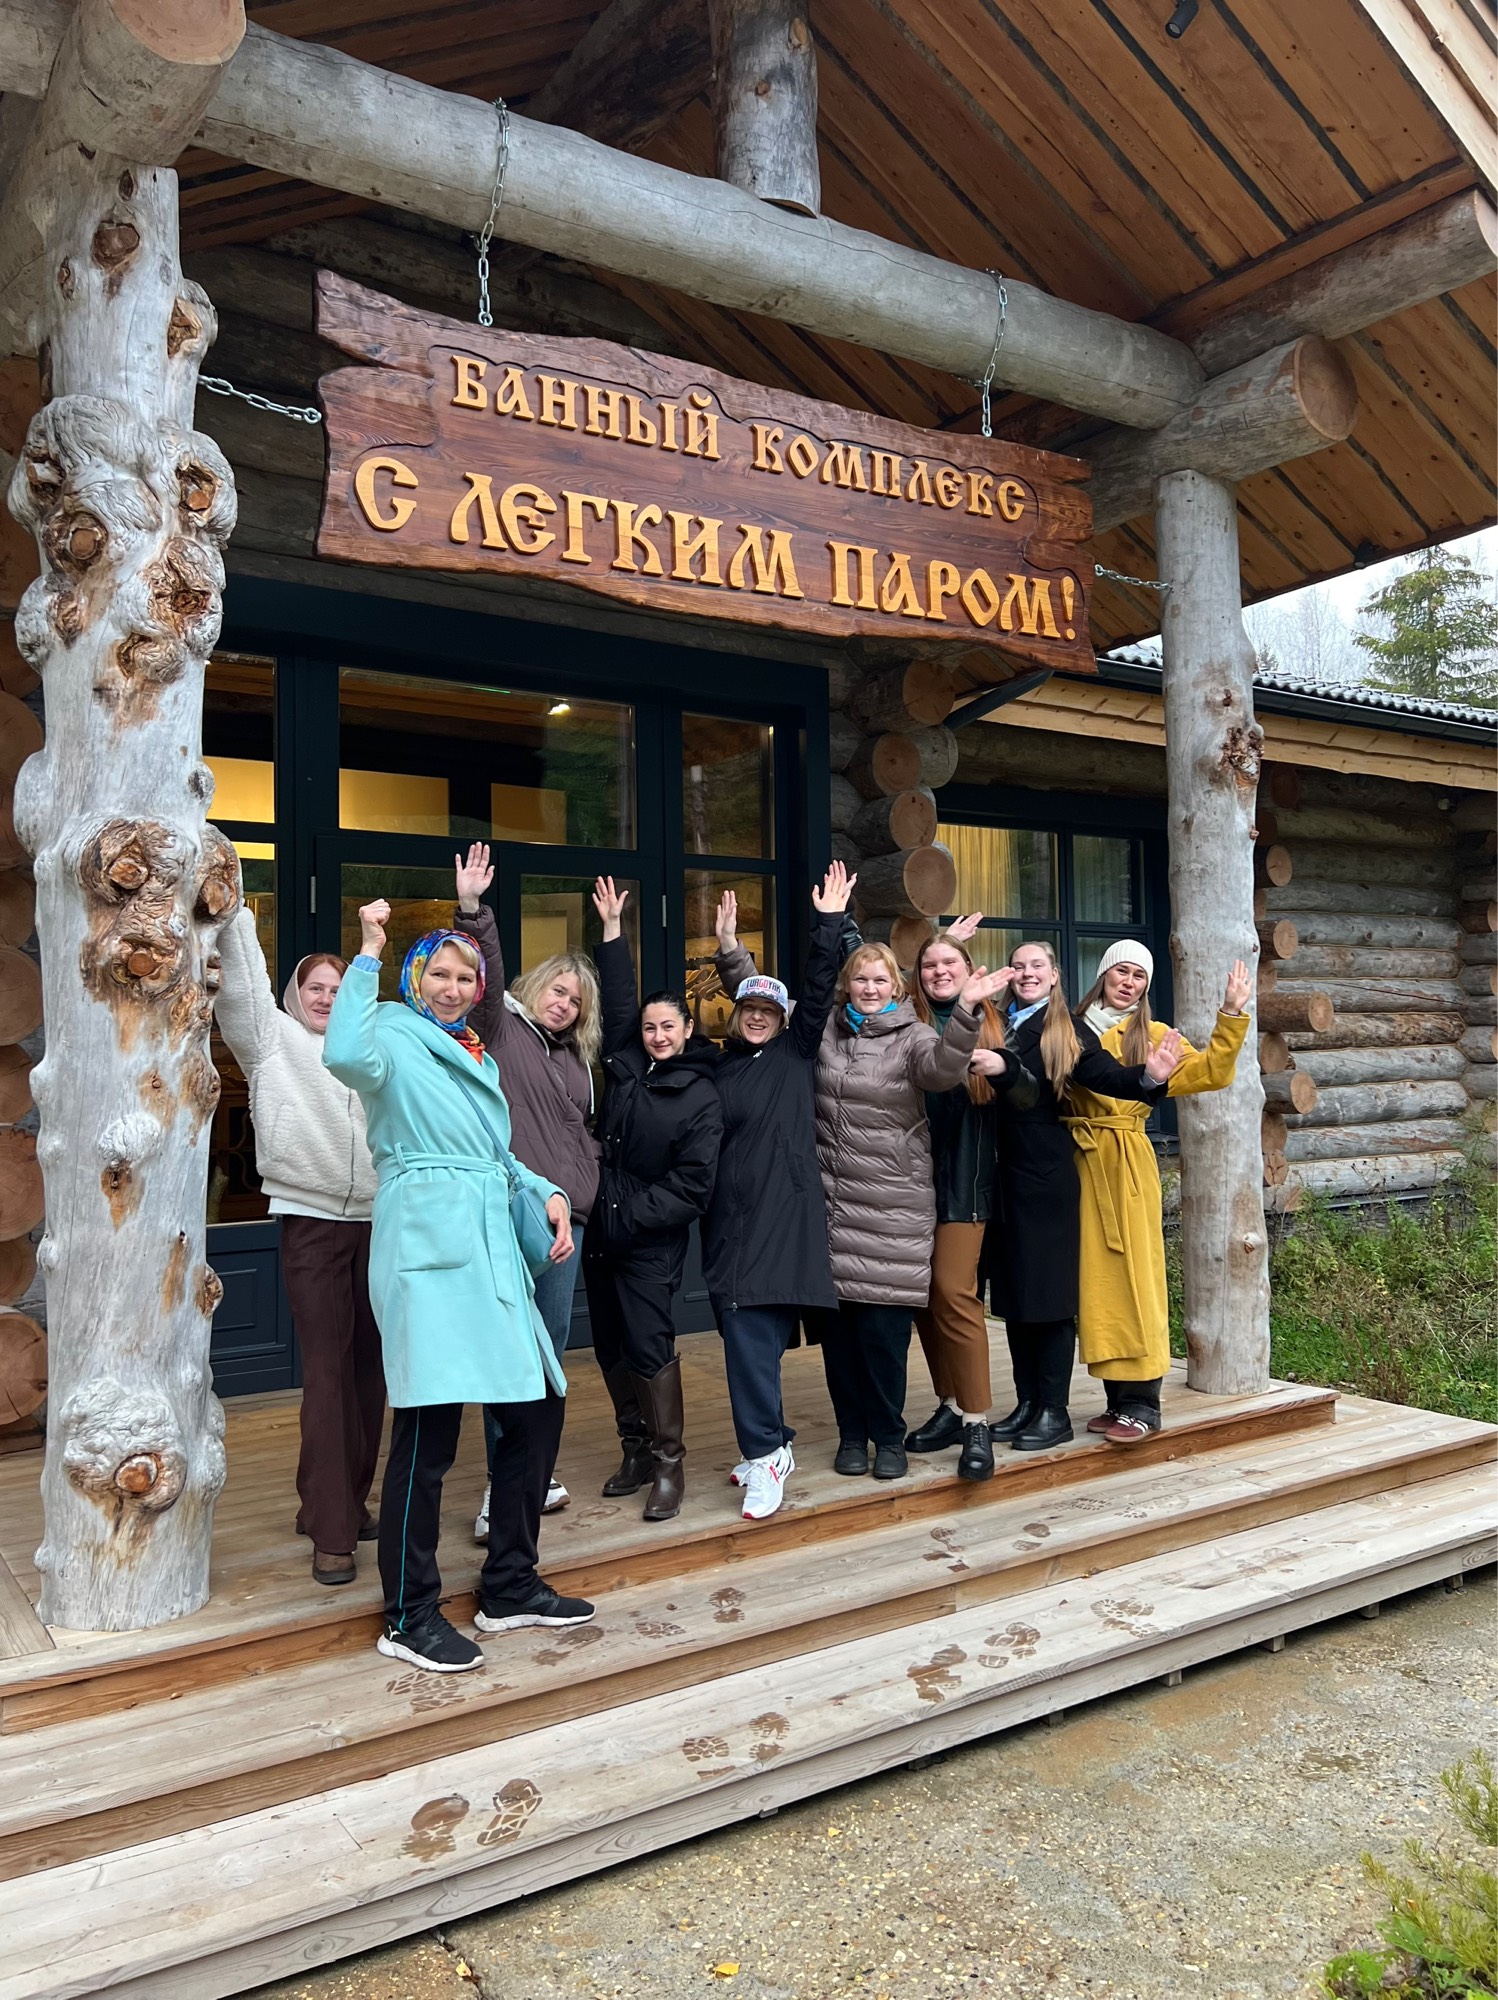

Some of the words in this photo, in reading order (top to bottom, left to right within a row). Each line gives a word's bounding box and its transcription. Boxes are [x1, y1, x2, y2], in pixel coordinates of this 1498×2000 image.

[450, 354, 721, 461] БАННЫЙ
[751, 423, 1027, 522] КОМПЛЕКС
[354, 456, 418, 531] С
[449, 472, 805, 600] ЛЕГКИМ
[827, 540, 1077, 641] ПАРОМ!
